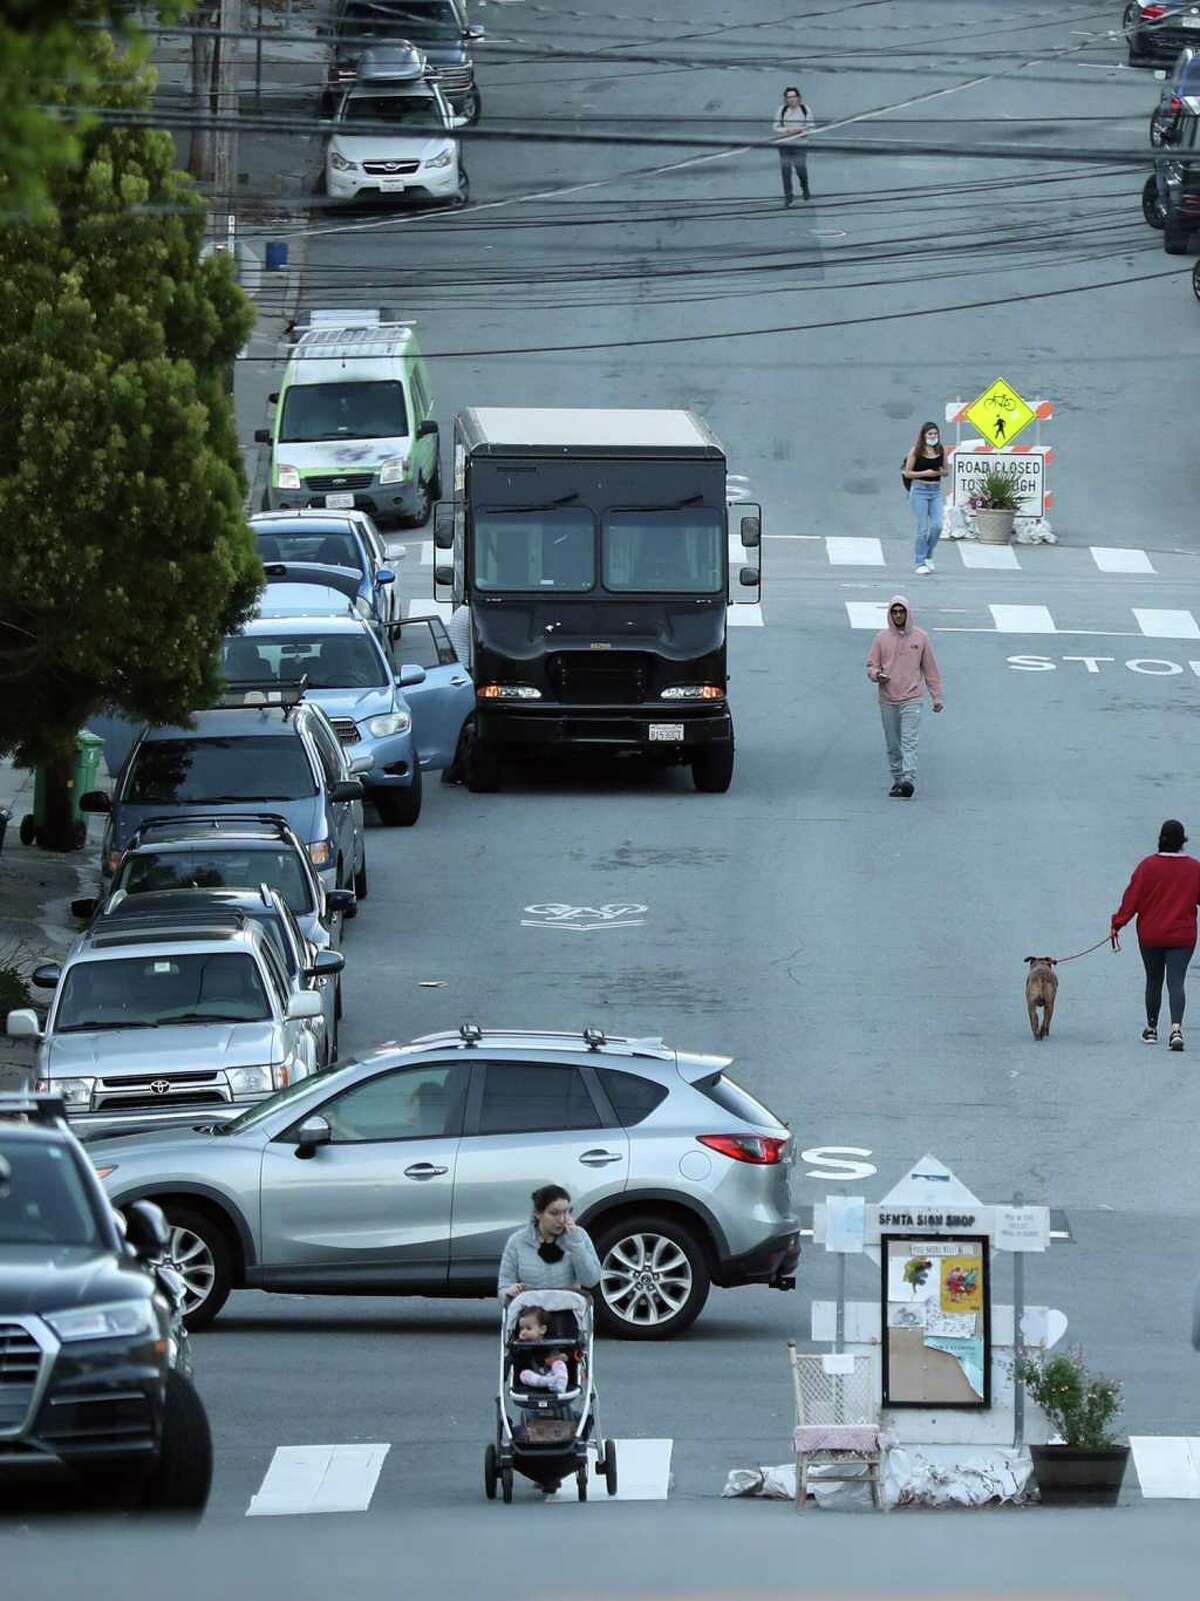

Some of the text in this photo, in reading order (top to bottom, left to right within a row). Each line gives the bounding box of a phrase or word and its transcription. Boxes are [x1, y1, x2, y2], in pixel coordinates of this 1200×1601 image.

[957, 461, 1040, 475] ROAD CLOSED
[961, 479, 975, 491] TO
